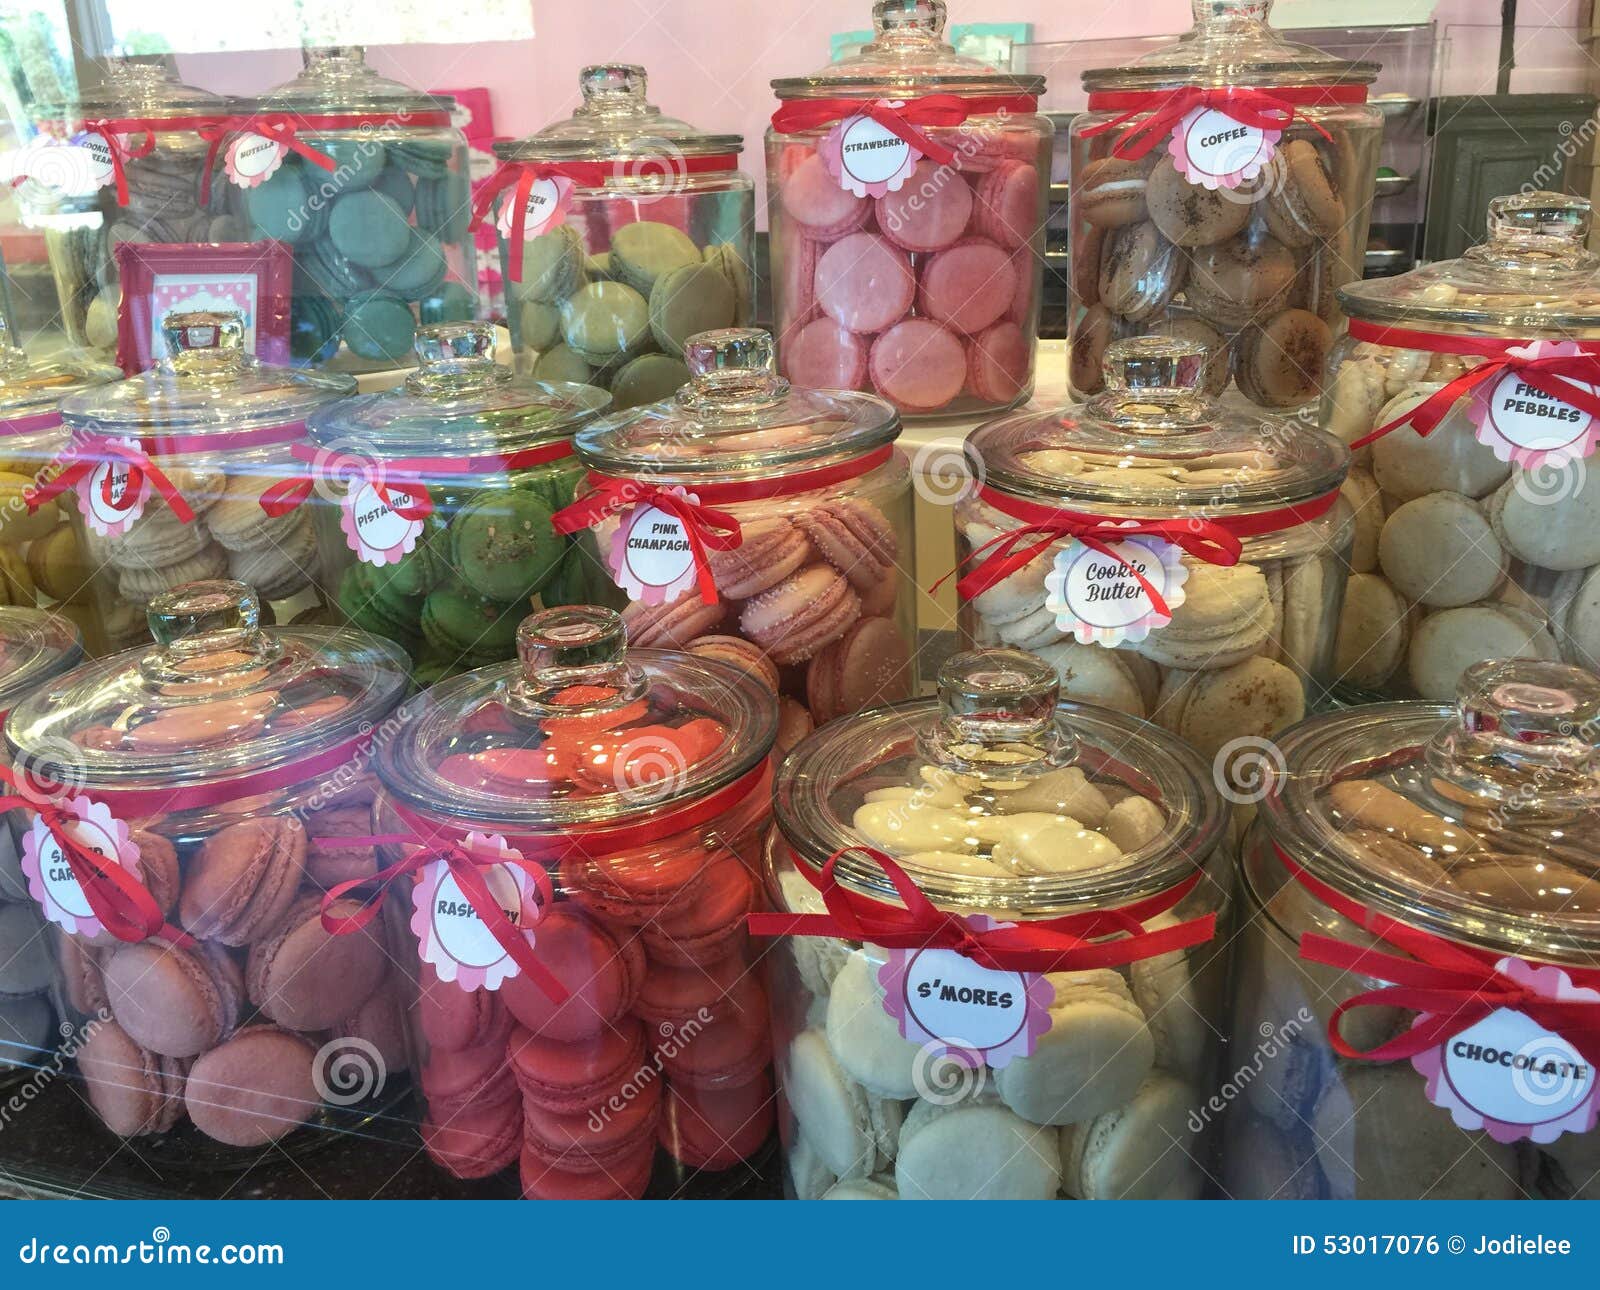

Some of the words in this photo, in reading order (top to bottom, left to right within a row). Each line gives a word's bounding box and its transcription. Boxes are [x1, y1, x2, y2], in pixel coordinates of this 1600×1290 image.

[844, 138, 905, 153] STRAWBERRY
[1200, 126, 1248, 148] COFFEE
[1503, 398, 1581, 422] PEBBLES
[652, 523, 679, 535] PINK
[627, 538, 693, 552] CHAMPAGN
[1086, 560, 1146, 581] Cookie
[1085, 582, 1144, 602] Butter
[917, 979, 1013, 1009] S'MORES
[1453, 1042, 1587, 1080] CHOCOLATE
